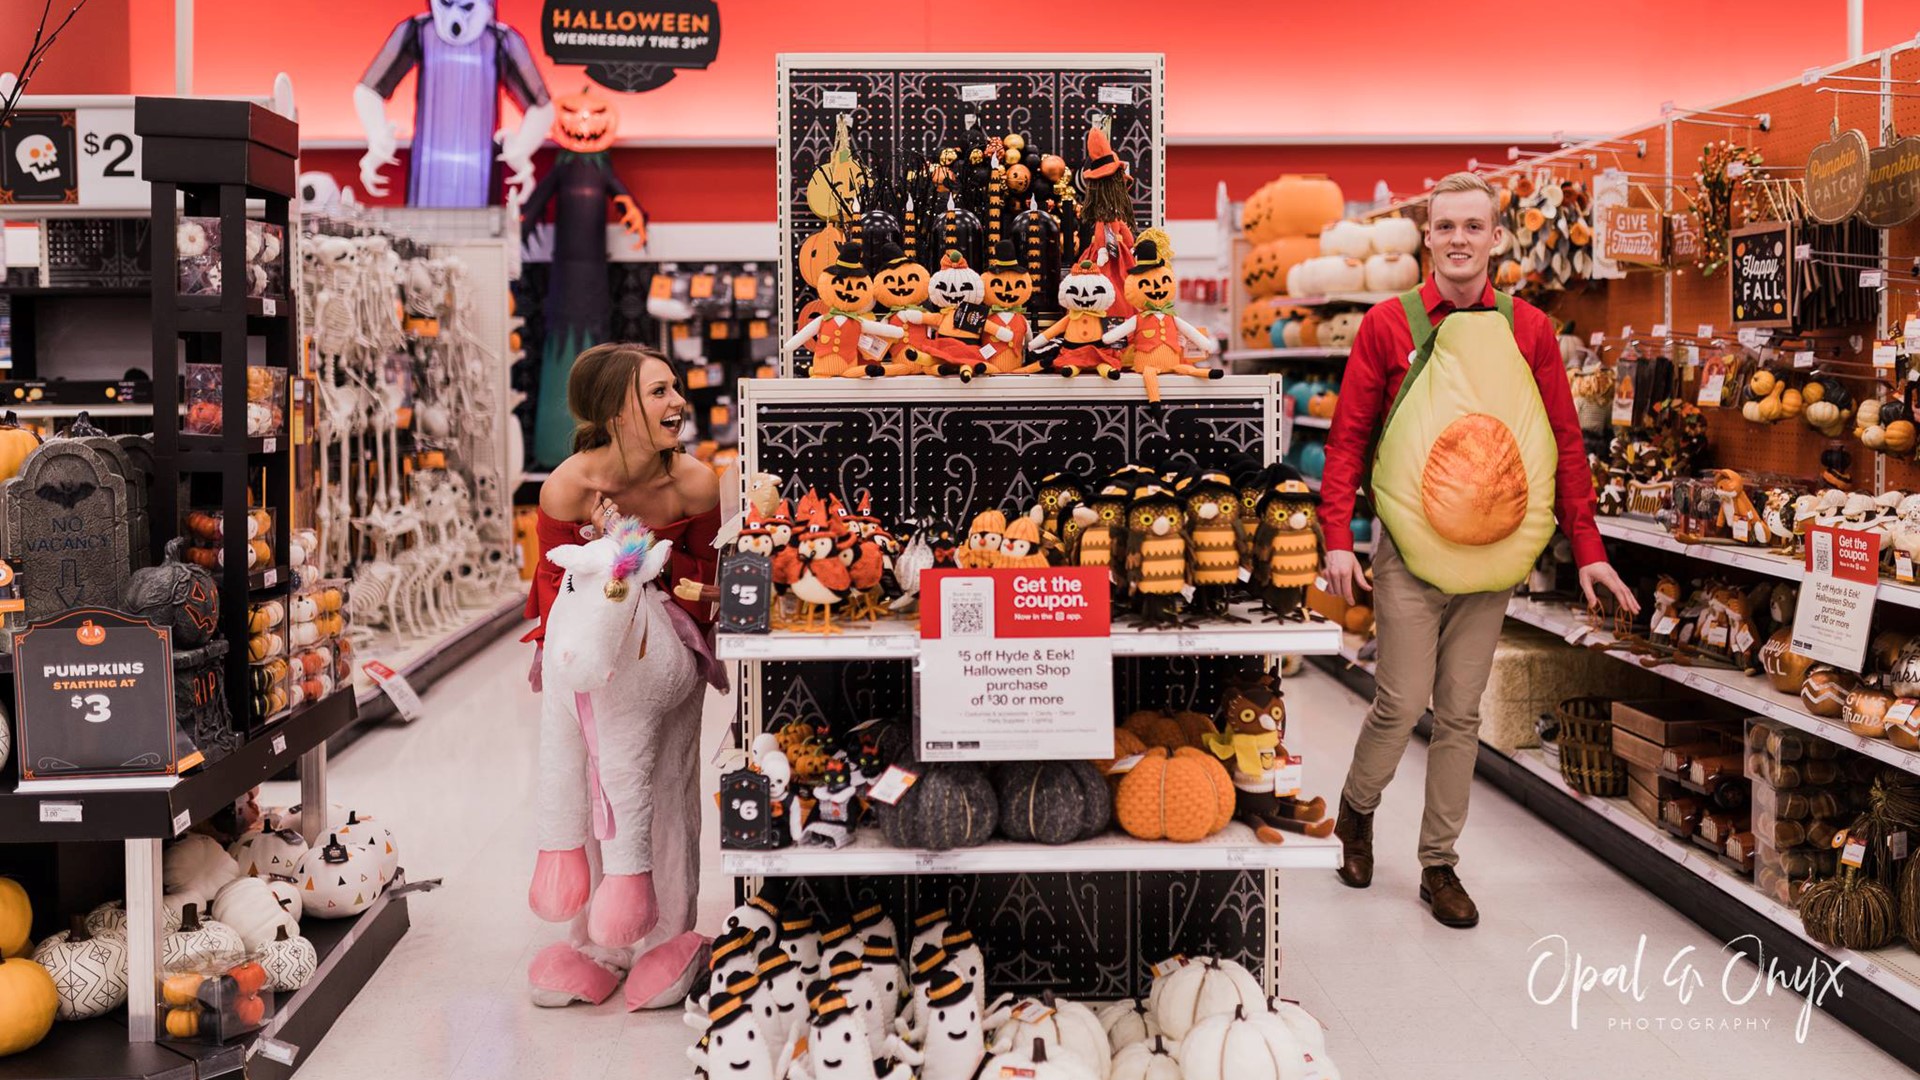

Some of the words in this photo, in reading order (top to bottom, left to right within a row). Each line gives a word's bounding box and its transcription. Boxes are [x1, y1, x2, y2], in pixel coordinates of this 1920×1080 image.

[553, 9, 709, 33] HALLOWEEN
[553, 32, 646, 48] WEDNESDAY
[649, 36, 679, 48] THE
[84, 131, 135, 177] $2
[1811, 147, 1858, 182] Pumpkin
[1870, 152, 1920, 183] umpkin
[1814, 172, 1858, 205] PATCH
[1864, 176, 1920, 210] PATCH
[1616, 213, 1648, 231] GIVE
[1612, 229, 1654, 256] Thanks
[1742, 254, 1780, 281] Happy
[1743, 280, 1781, 301] FALL
[52, 516, 84, 533] NO
[25, 534, 110, 552] VACANCY
[1839, 534, 1853, 548] Get
[1854, 537, 1868, 551] the
[1838, 548, 1869, 562] coupon.
[1013, 575, 1047, 594] Get
[1051, 575, 1082, 593] the
[731, 583, 759, 606] $5
[1013, 594, 1088, 612] coupon.
[1815, 592, 1842, 606] Halloween
[1842, 598, 1857, 610] Shop
[1014, 613, 1032, 621] Now
[1066, 614, 1082, 622] app.
[1821, 605, 1846, 618] purchase
[1836, 619, 1850, 630] more
[958, 650, 972, 662] $5
[974, 650, 992, 662] off
[995, 650, 1030, 664] Hyde
[1033, 650, 1042, 661] &
[1046, 649, 1075, 661] Eek!
[43, 662, 145, 678] PUMPKINS
[963, 665, 1033, 677] Halloween
[1036, 664, 1071, 677] Shop
[53, 679, 117, 691] STARTING
[119, 678, 136, 688] AT
[192, 671, 216, 707] RIP
[986, 680, 1048, 693] purchase
[71, 693, 112, 723] $3
[971, 694, 984, 706] of
[987, 694, 1008, 706] $30
[1012, 696, 1025, 705] or
[1029, 695, 1064, 705] more
[731, 798, 759, 821] $6
